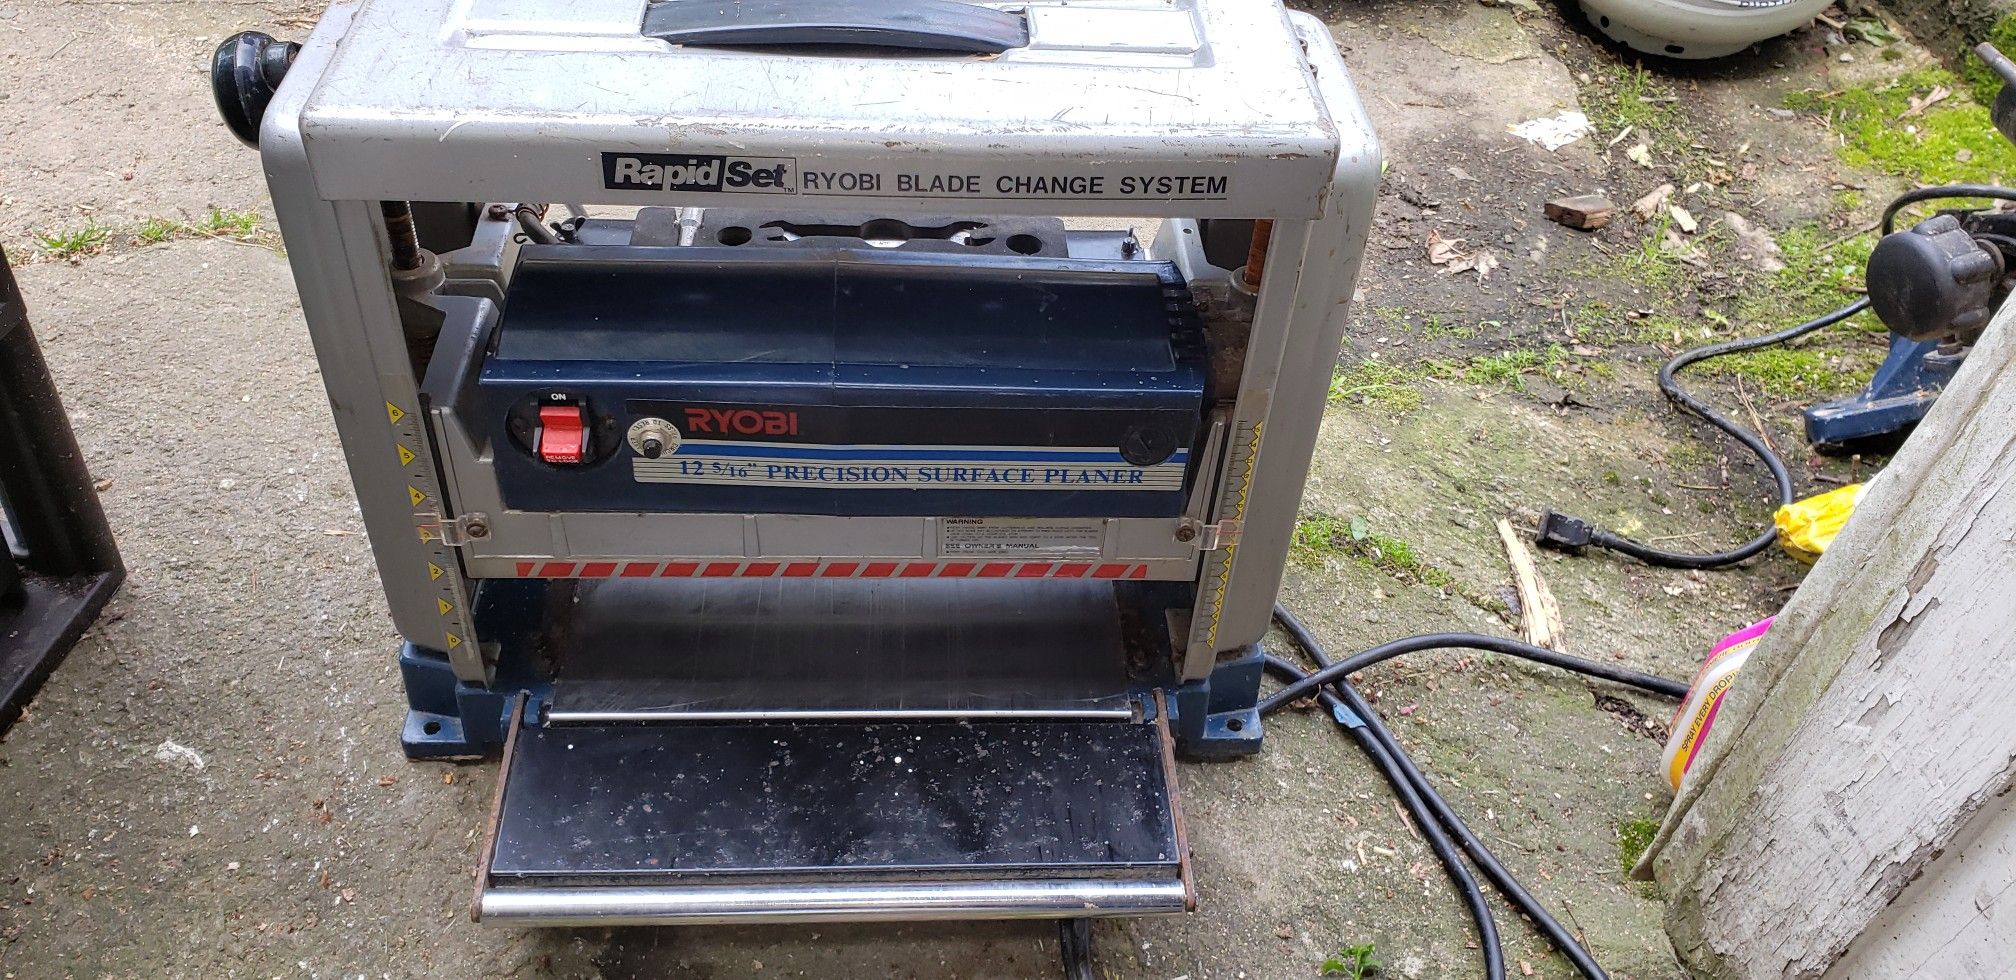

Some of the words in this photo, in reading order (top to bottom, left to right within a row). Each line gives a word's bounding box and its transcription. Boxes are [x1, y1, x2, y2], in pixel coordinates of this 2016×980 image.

[614, 157, 721, 191] Rapid
[725, 161, 787, 188] Set
[803, 171, 881, 191] RYOBI
[897, 174, 981, 193] BLADE
[996, 175, 1104, 194] CHANGE
[1119, 176, 1228, 194] SYSTEM
[550, 393, 567, 401] ON
[684, 408, 798, 435] RYOBI
[680, 460, 705, 476] 12
[767, 464, 908, 482] PRECISION
[918, 467, 1035, 483] SURFACE
[1045, 469, 1144, 484] PLANER
[1682, 724, 1697, 752] SPRAY
[1694, 697, 1711, 727] EVERY
